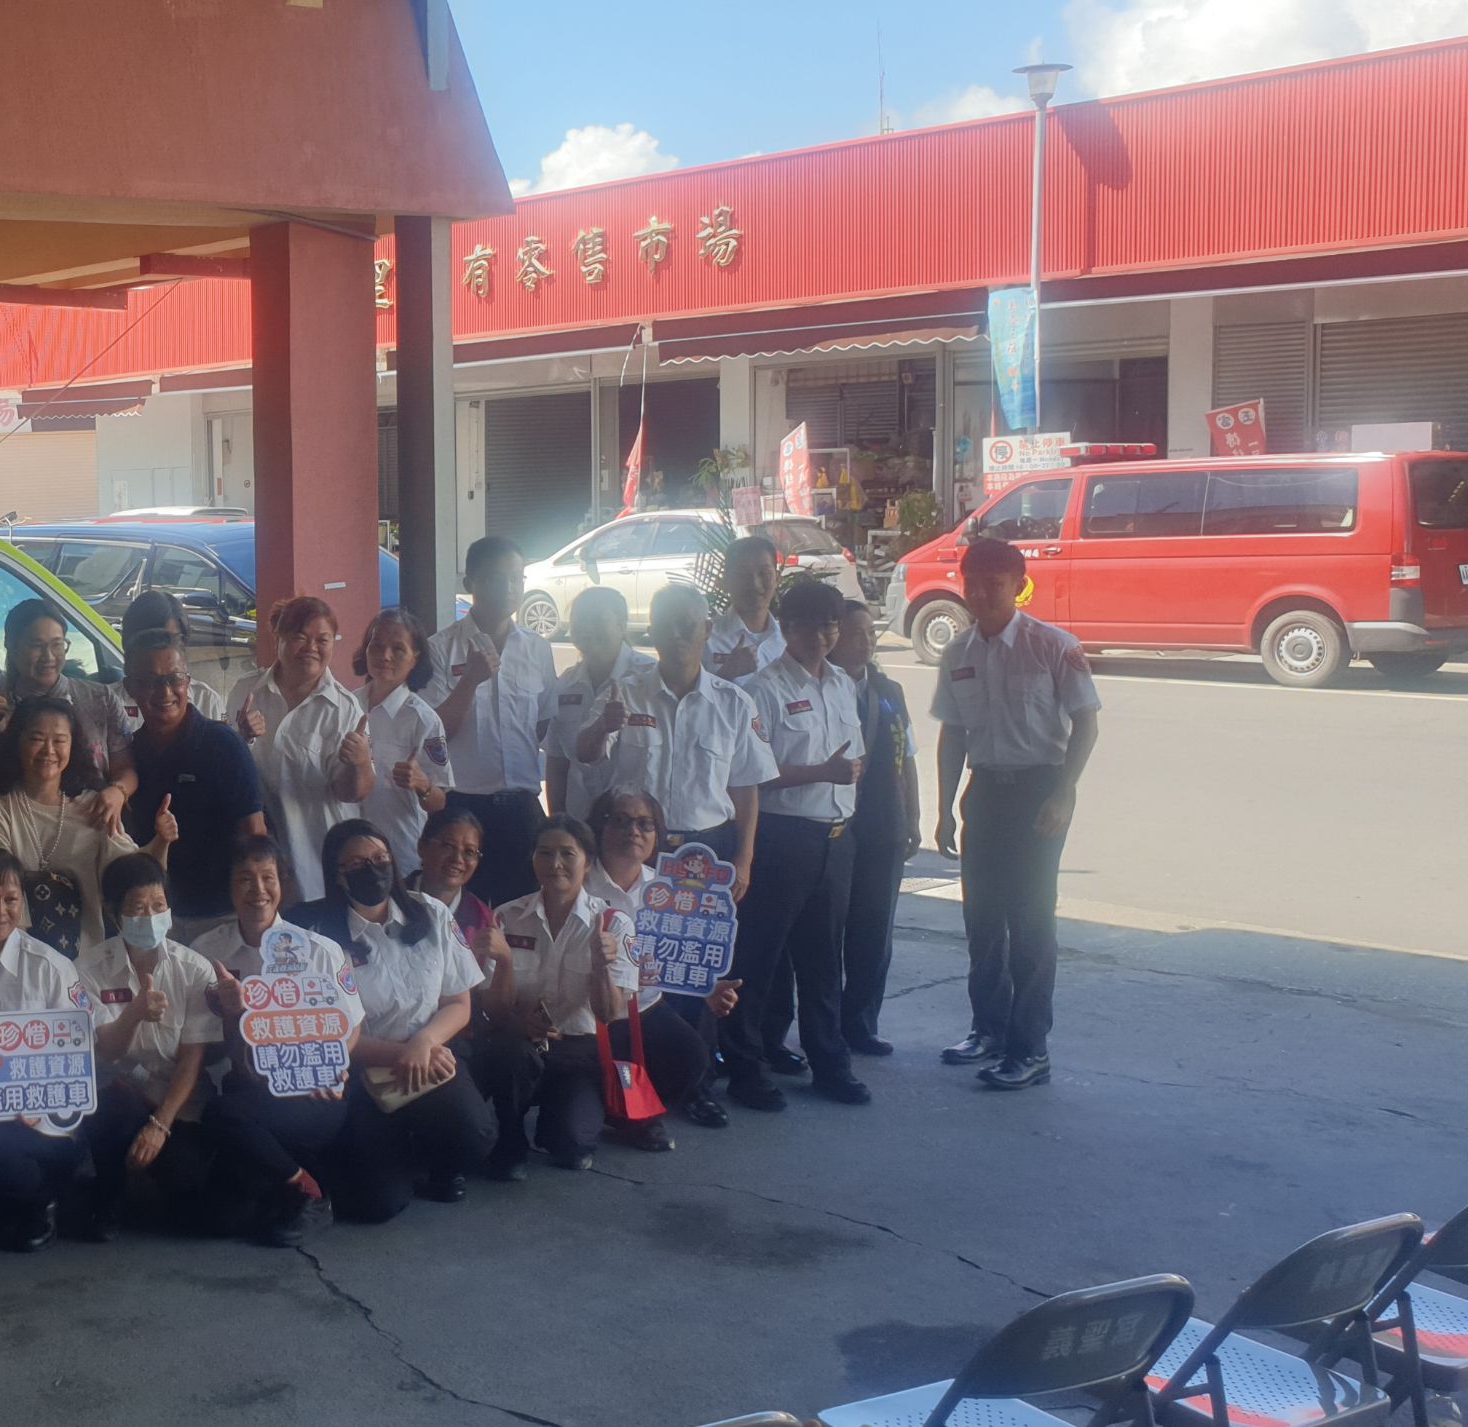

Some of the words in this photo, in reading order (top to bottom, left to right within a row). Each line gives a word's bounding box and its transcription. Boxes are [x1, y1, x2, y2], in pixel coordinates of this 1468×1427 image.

[462, 206, 743, 299] 有零售市場
[648, 886, 695, 914] 珍惜
[637, 910, 731, 942] 救護資源
[245, 980, 298, 1007] 珍惜
[250, 1012, 343, 1041] 救護資源
[9, 1053, 85, 1080] 救護資源
[256, 1040, 346, 1070] 請勿濫用
[273, 1066, 336, 1093] 救護車
